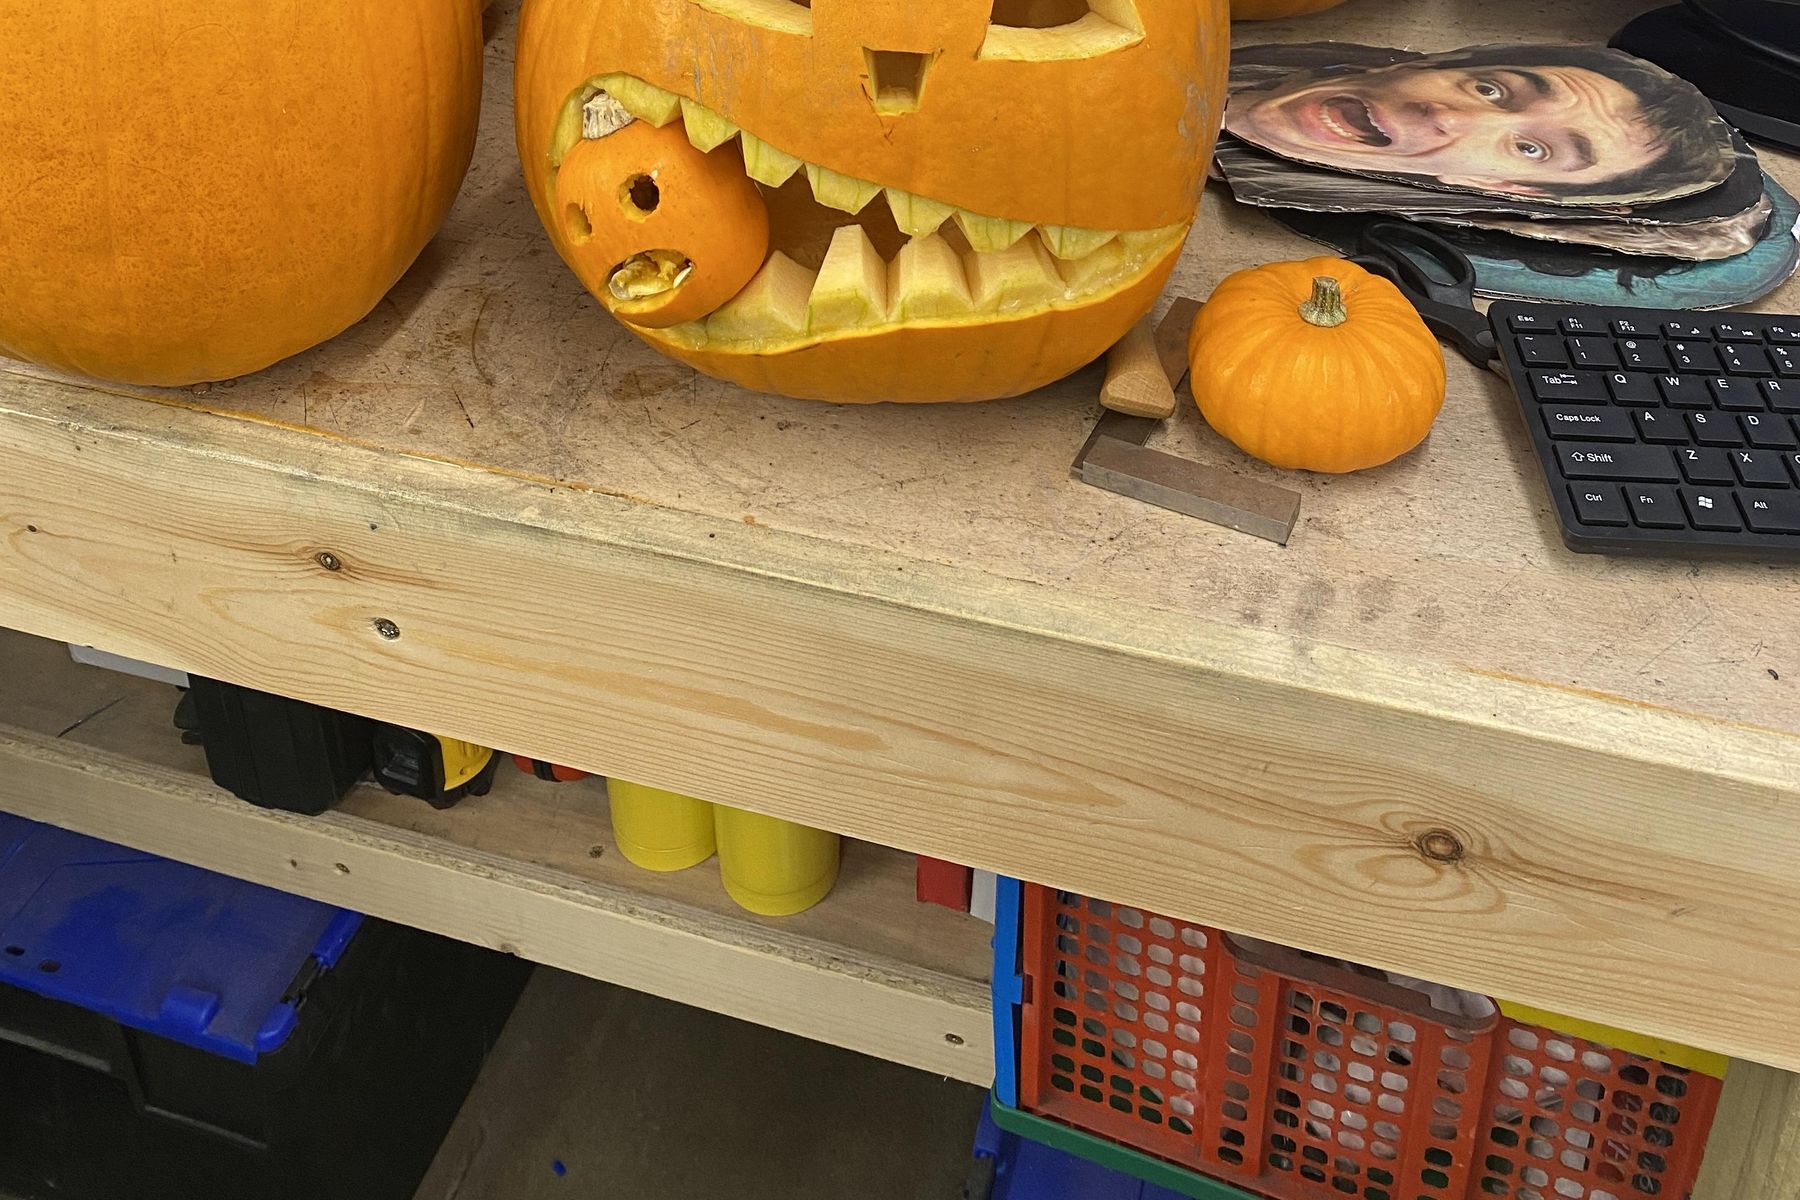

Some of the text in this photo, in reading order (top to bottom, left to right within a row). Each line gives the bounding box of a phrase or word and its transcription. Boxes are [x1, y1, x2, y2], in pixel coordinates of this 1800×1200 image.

[1632, 353, 1641, 362] 2
[1682, 355, 1691, 363] 3
[1733, 358, 1741, 366] 4
[1784, 360, 1793, 368] 5
[1541, 375, 1562, 384] Tab
[1614, 374, 1627, 384] Q
[1665, 376, 1680, 386] W
[1717, 379, 1729, 389] E
[1768, 381, 1781, 391] R
[1556, 413, 1602, 422] Caps Lock
[1644, 411, 1656, 421] A
[1695, 413, 1707, 423] S
[1747, 415, 1760, 425] D
[1586, 453, 1614, 463] Shift
[1686, 449, 1698, 460] Z
[1739, 452, 1753, 463] X
[1585, 493, 1603, 502] Ctrl
[1640, 495, 1654, 504] Fn
[1754, 501, 1769, 509] Alt
